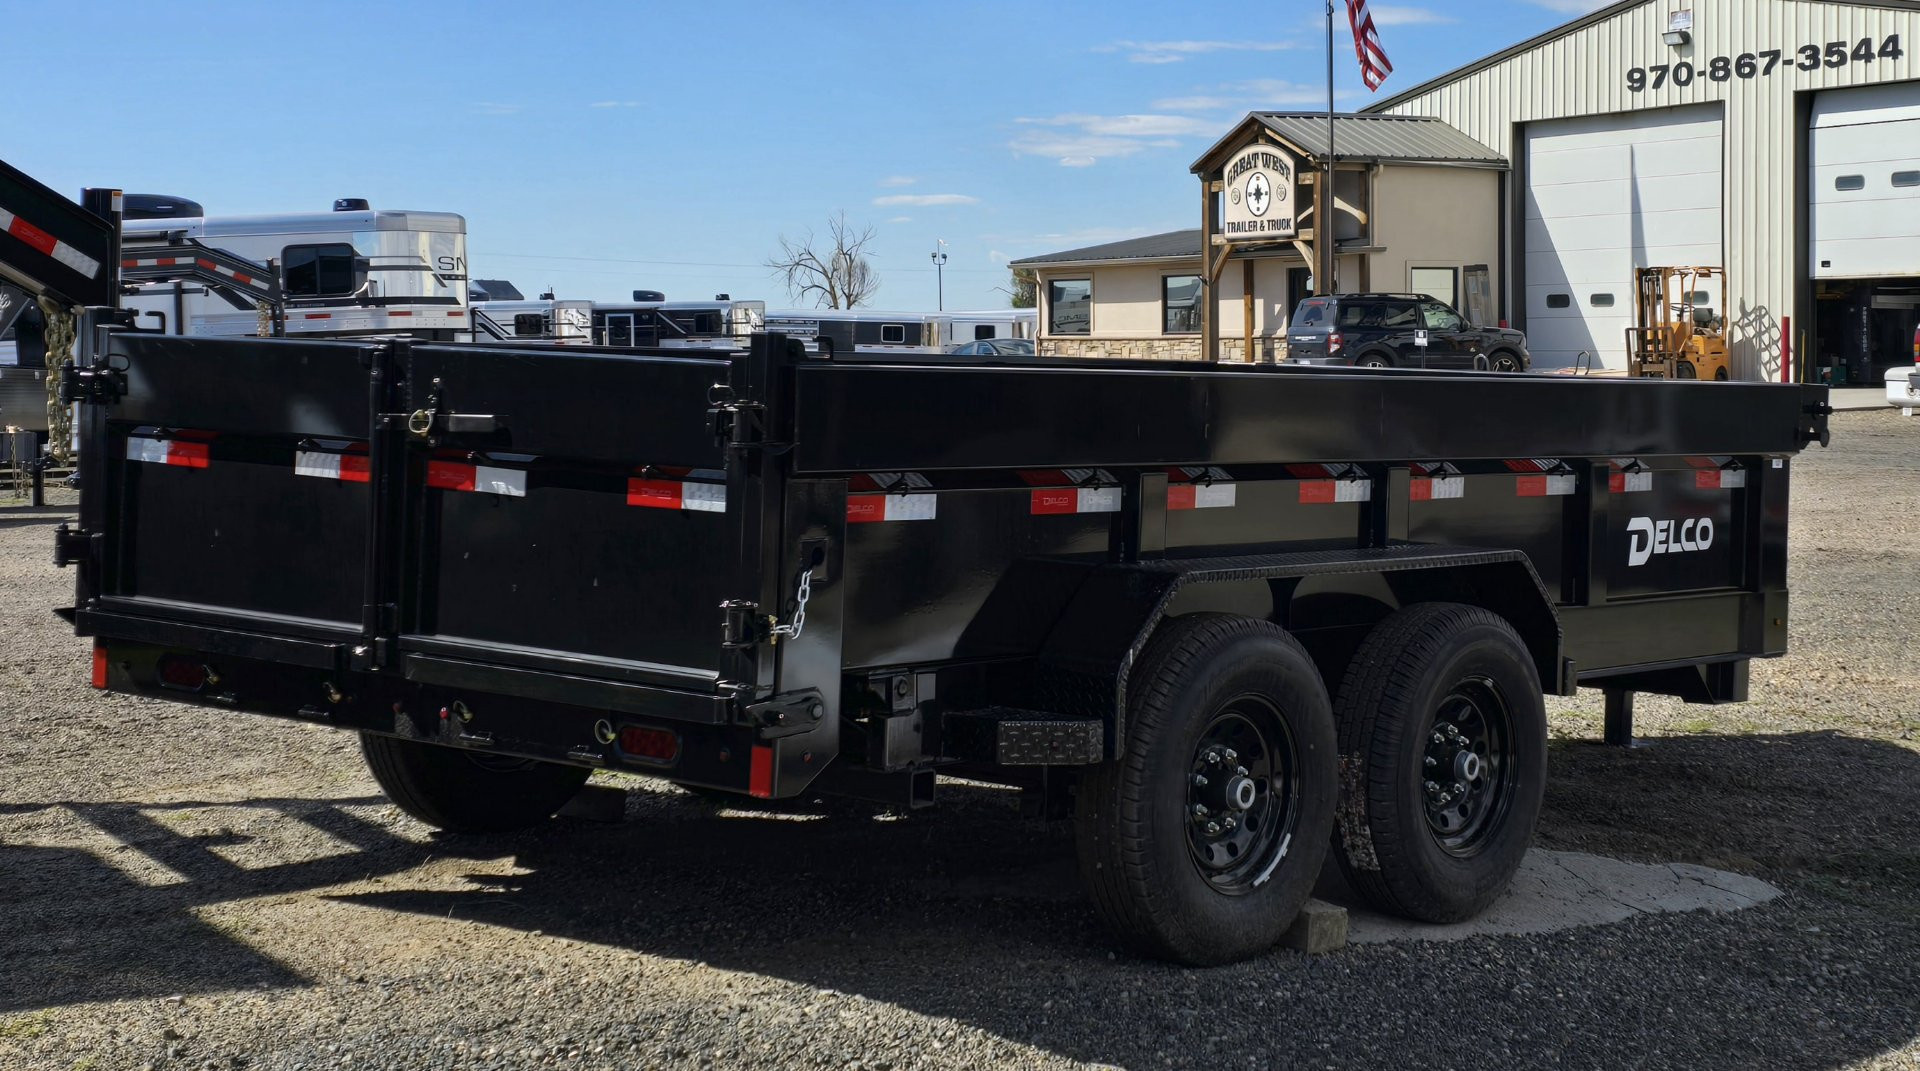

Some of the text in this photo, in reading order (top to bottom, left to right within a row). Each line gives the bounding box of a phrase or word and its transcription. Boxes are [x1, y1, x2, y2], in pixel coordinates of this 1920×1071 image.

[1626, 34, 1904, 92] 970-867-3544
[1227, 152, 1291, 187] GREAT WEST
[1227, 217, 1292, 233] TRAILER & TRUCK
[1626, 516, 1714, 567] DELCO
